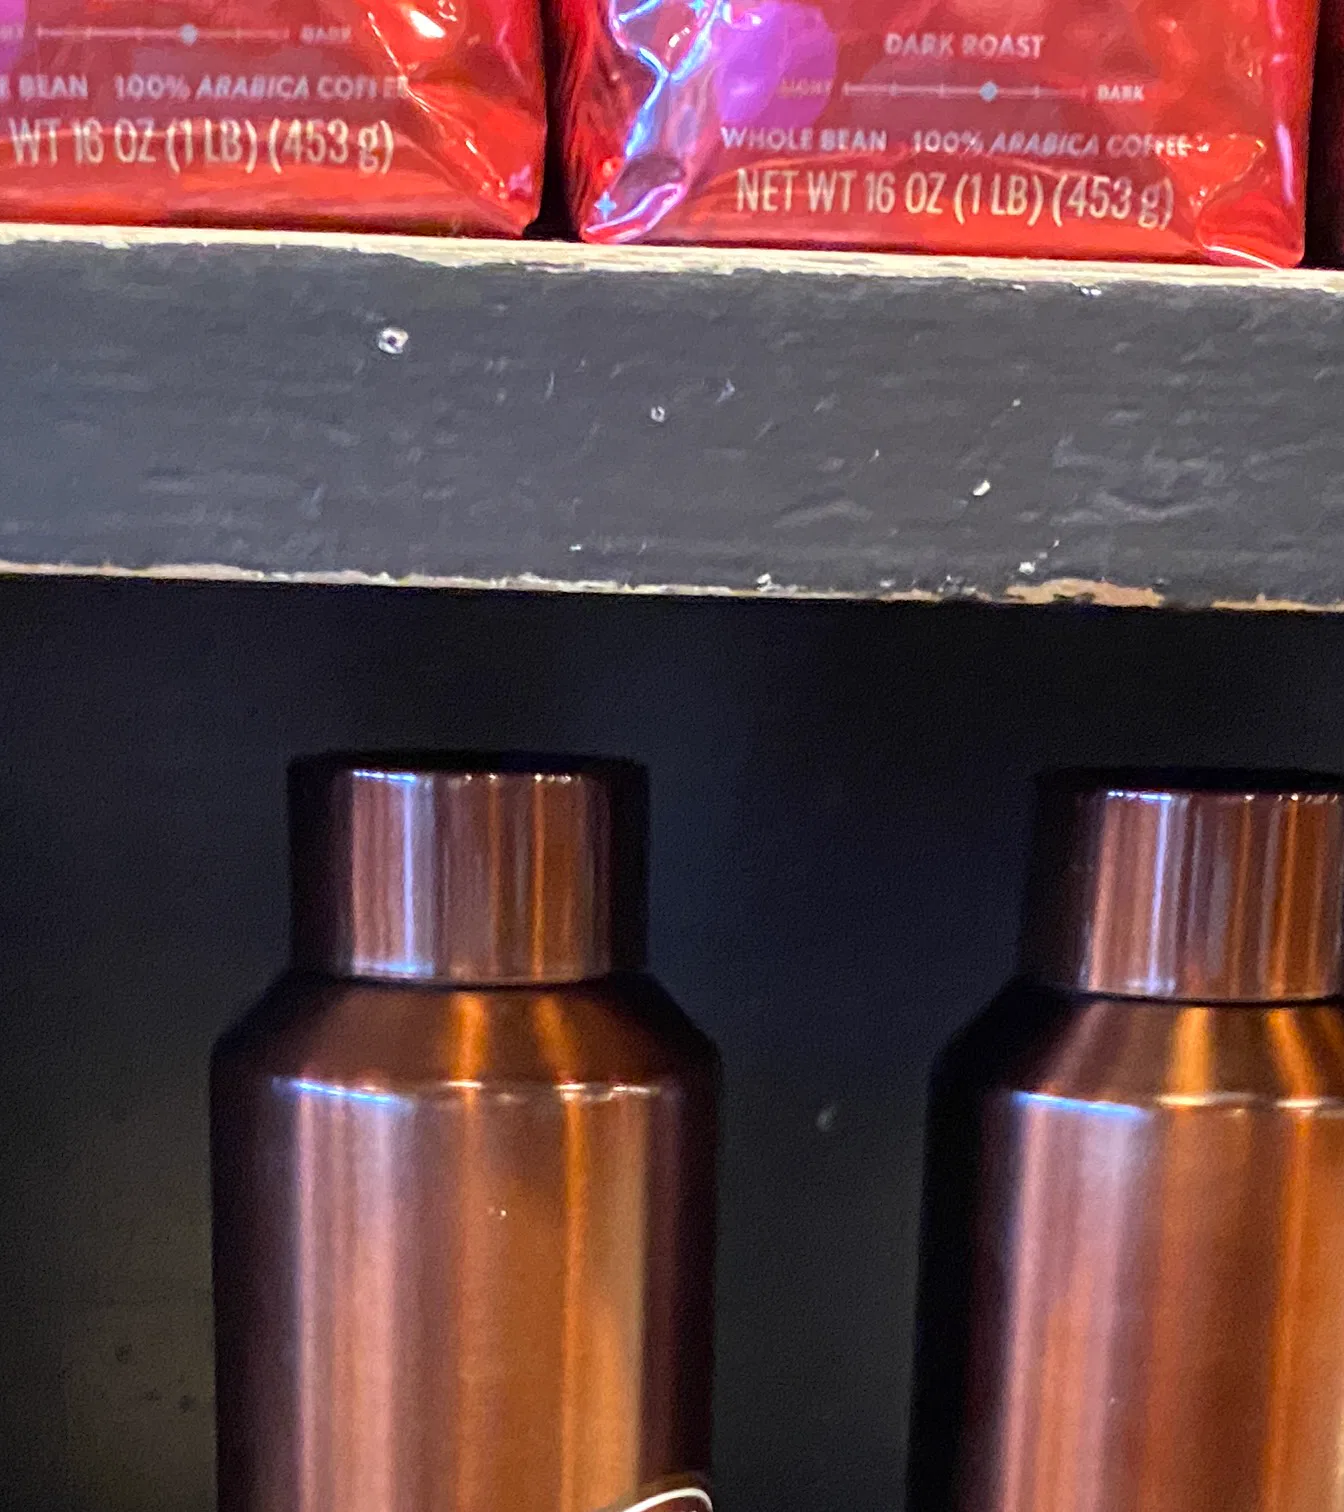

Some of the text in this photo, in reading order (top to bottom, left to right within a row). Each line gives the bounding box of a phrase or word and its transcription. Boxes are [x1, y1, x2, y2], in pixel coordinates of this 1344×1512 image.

[885, 32, 1044, 59] DARK ROAST
[18, 74, 89, 99] BEAN
[115, 74, 192, 100] 100%
[194, 74, 311, 100] ARABICA
[9, 116, 62, 167] WT
[72, 117, 105, 165] 16
[113, 116, 157, 164] OZ
[268, 116, 350, 175] (453
[358, 119, 395, 175] g)
[720, 125, 1191, 158] WHOLE BEAN 100% ARABICA COFFEE
[736, 167, 800, 213] NET
[808, 168, 859, 213] WT
[864, 170, 897, 214] 16
[905, 170, 947, 215] OZ
[1051, 173, 1133, 227] (453
[1137, 176, 1175, 231] g)
